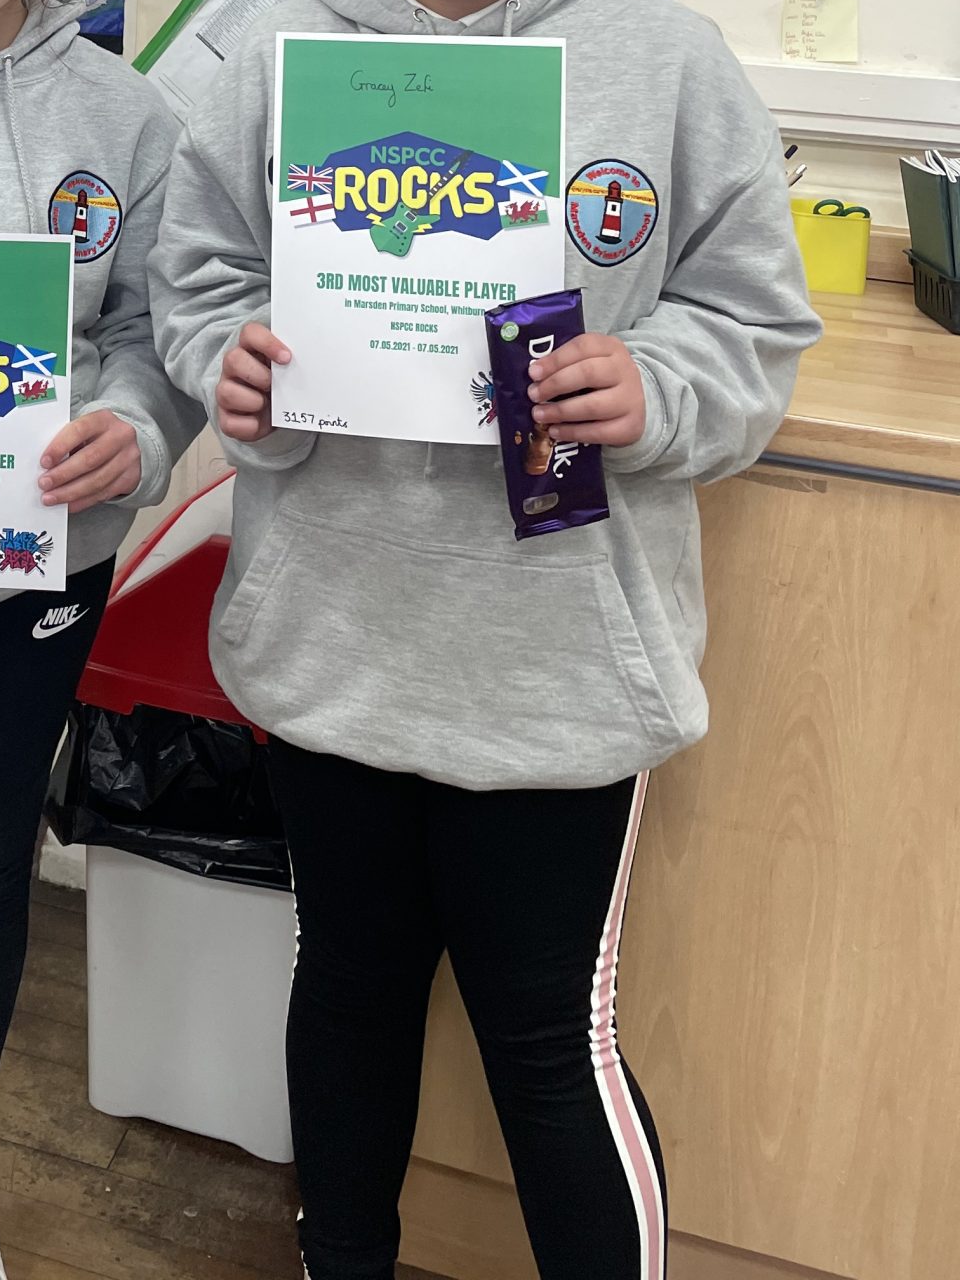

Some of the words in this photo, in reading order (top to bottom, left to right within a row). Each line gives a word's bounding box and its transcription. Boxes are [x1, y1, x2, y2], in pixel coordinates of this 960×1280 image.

[370, 145, 446, 167] NSPCC
[334, 165, 495, 218] ROCKS
[316, 272, 343, 290] 3RD
[348, 274, 387, 293] MOST
[391, 276, 460, 298] VALUABLE
[464, 281, 517, 301] PLAYER
[344, 298, 352, 307] in
[354, 299, 387, 310] Marsden
[389, 301, 418, 313] Primary
[420, 303, 449, 315] School,
[451, 305, 486, 317] Whitburn
[390, 321, 414, 332] NSPCC
[415, 322, 439, 333] ROCKS
[369, 339, 411, 351] 07.05.2021
[417, 342, 459, 355] 07.05.2021
[282, 411, 316, 425] 3157
[318, 414, 348, 430] points
[41, 603, 80, 626] NIKE
